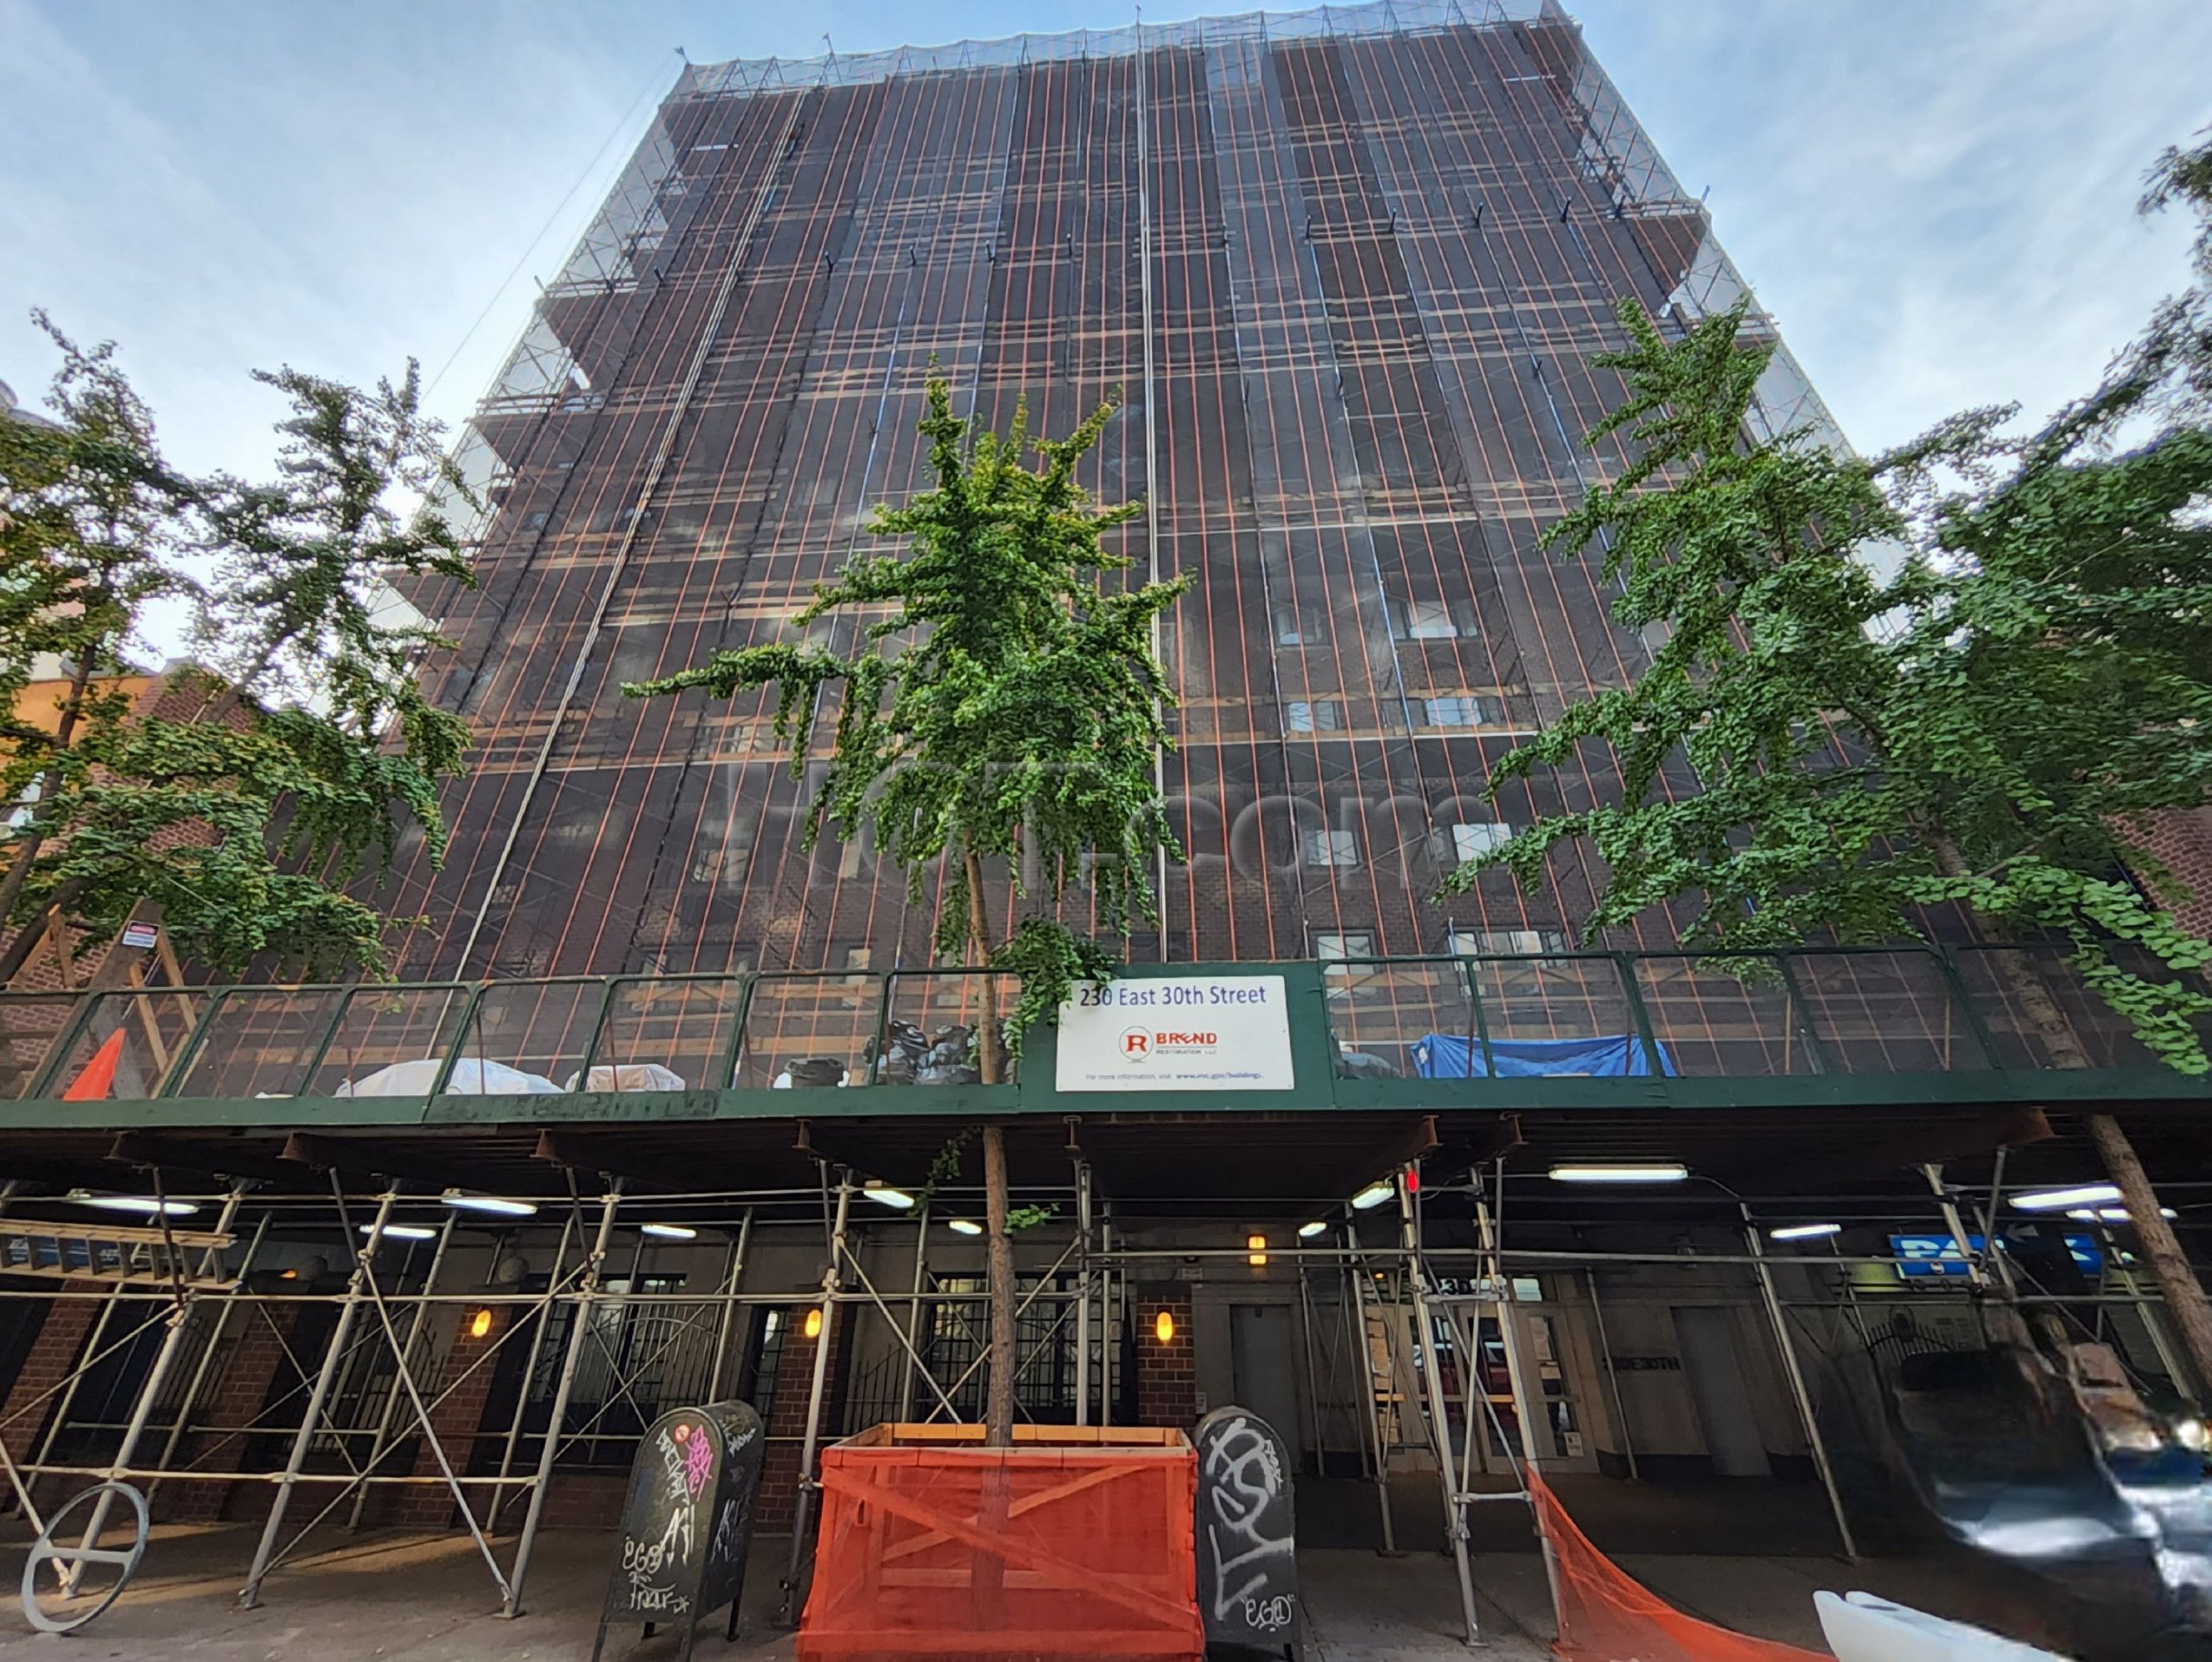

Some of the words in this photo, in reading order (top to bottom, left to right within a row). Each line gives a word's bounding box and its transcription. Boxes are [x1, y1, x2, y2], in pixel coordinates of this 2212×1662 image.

[1080, 987, 1112, 1007] 230
[1119, 987, 1156, 1006] East
[1161, 985, 1204, 1005] 30th
[1210, 984, 1267, 1004] Street
[1126, 1035, 1148, 1053] R
